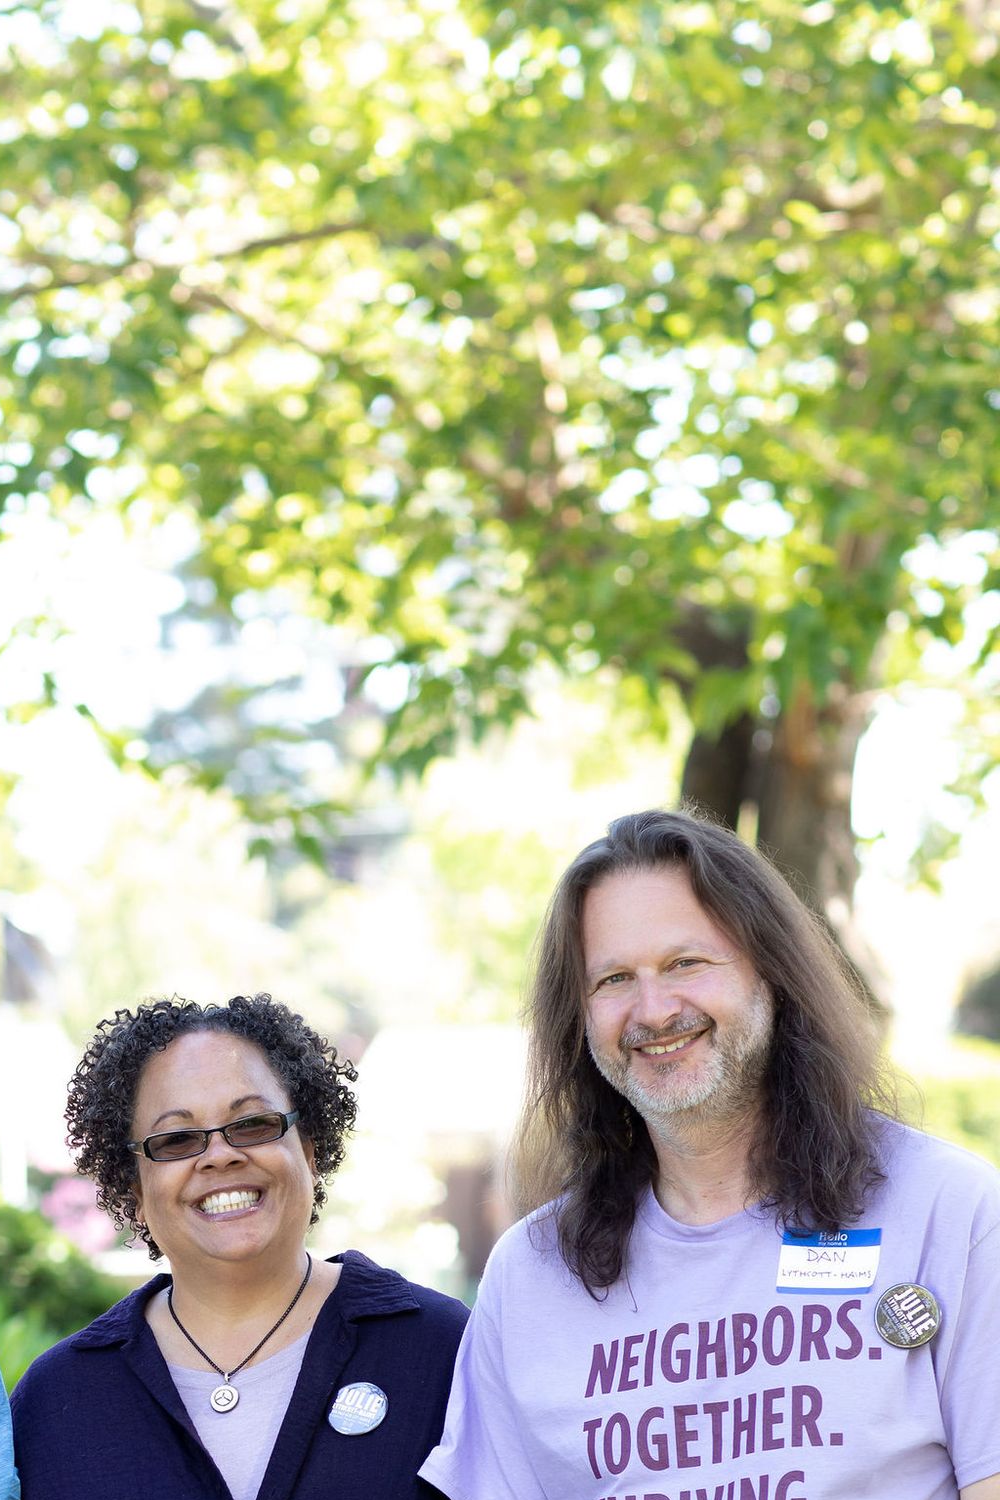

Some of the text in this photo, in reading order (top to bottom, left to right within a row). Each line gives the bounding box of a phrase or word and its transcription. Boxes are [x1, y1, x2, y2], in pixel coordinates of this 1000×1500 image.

[819, 1231, 848, 1241] Hello
[806, 1249, 847, 1262] DAN
[893, 1287, 937, 1336] JULIE
[584, 1299, 882, 1398] NEIGHBORS.
[335, 1388, 384, 1412] JULIE
[583, 1385, 844, 1479] TOGETHER.
